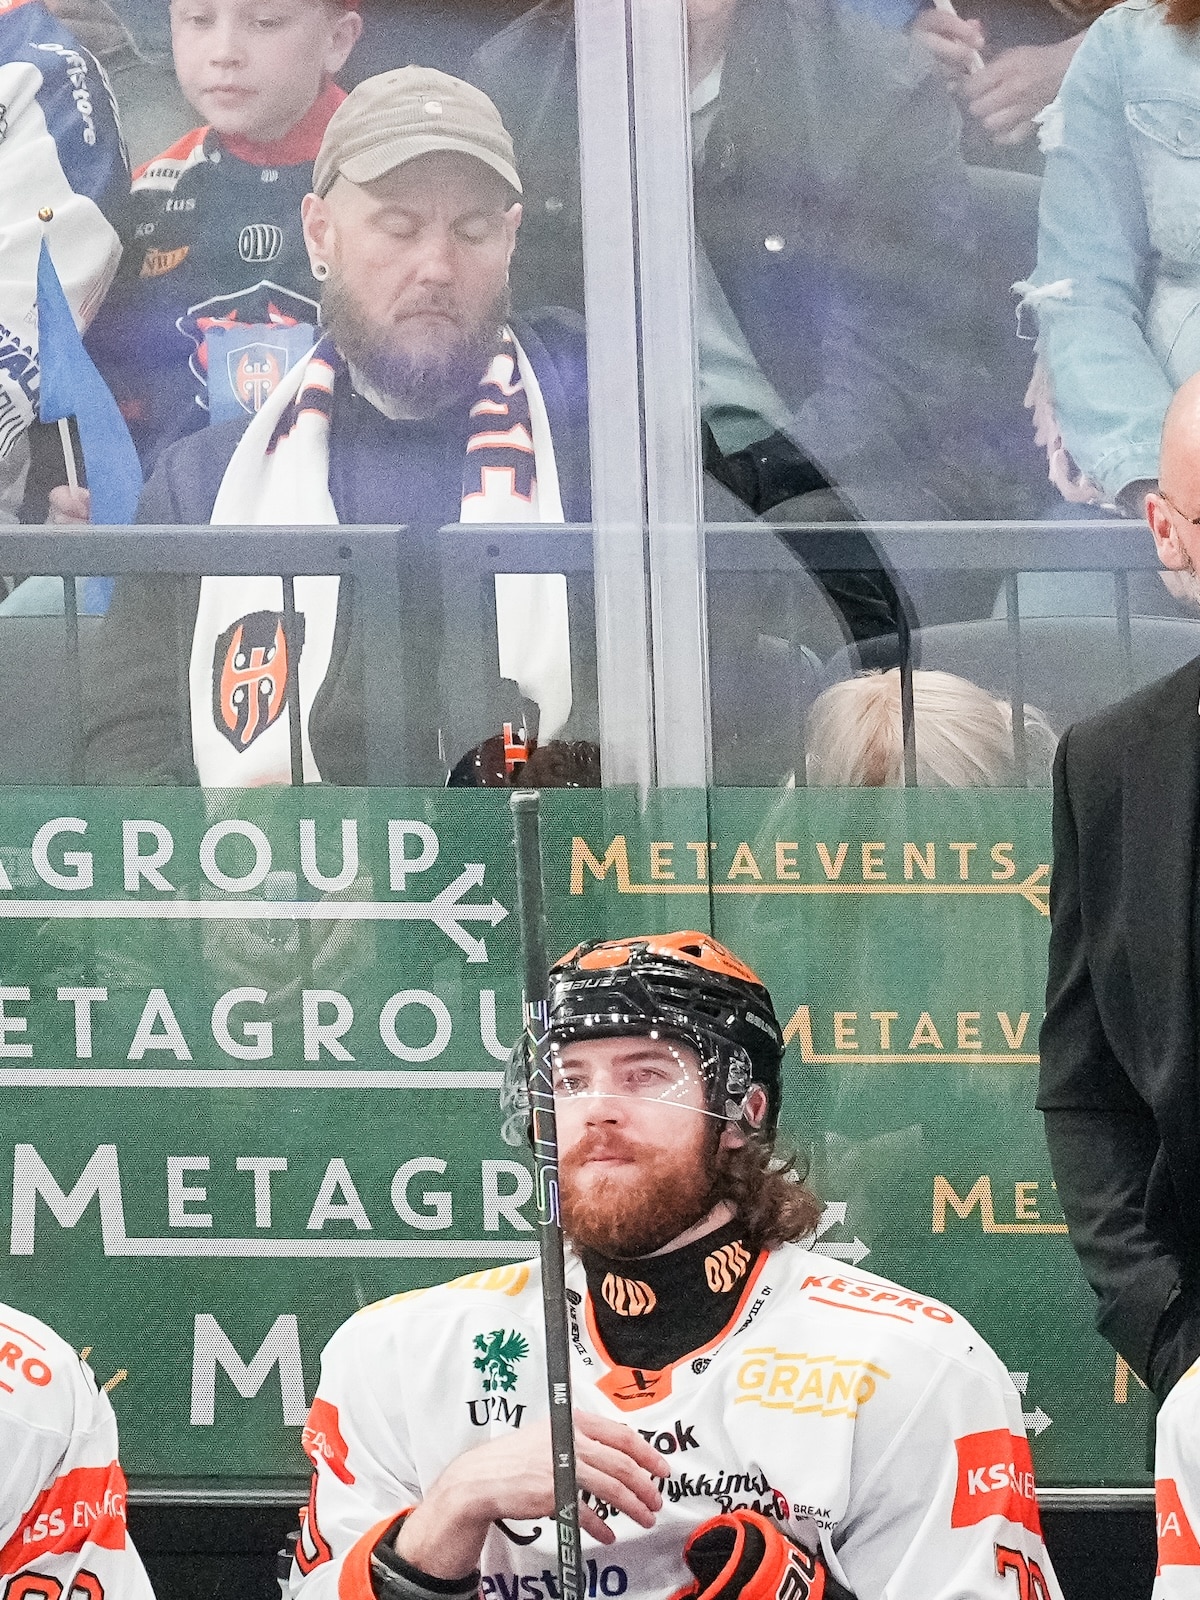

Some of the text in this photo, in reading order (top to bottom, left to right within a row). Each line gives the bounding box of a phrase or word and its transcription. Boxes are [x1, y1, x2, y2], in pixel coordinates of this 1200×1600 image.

[800, 1274, 954, 1325] KESPRO
[465, 1395, 527, 1429] UM
[793, 1503, 832, 1519] BREAK
